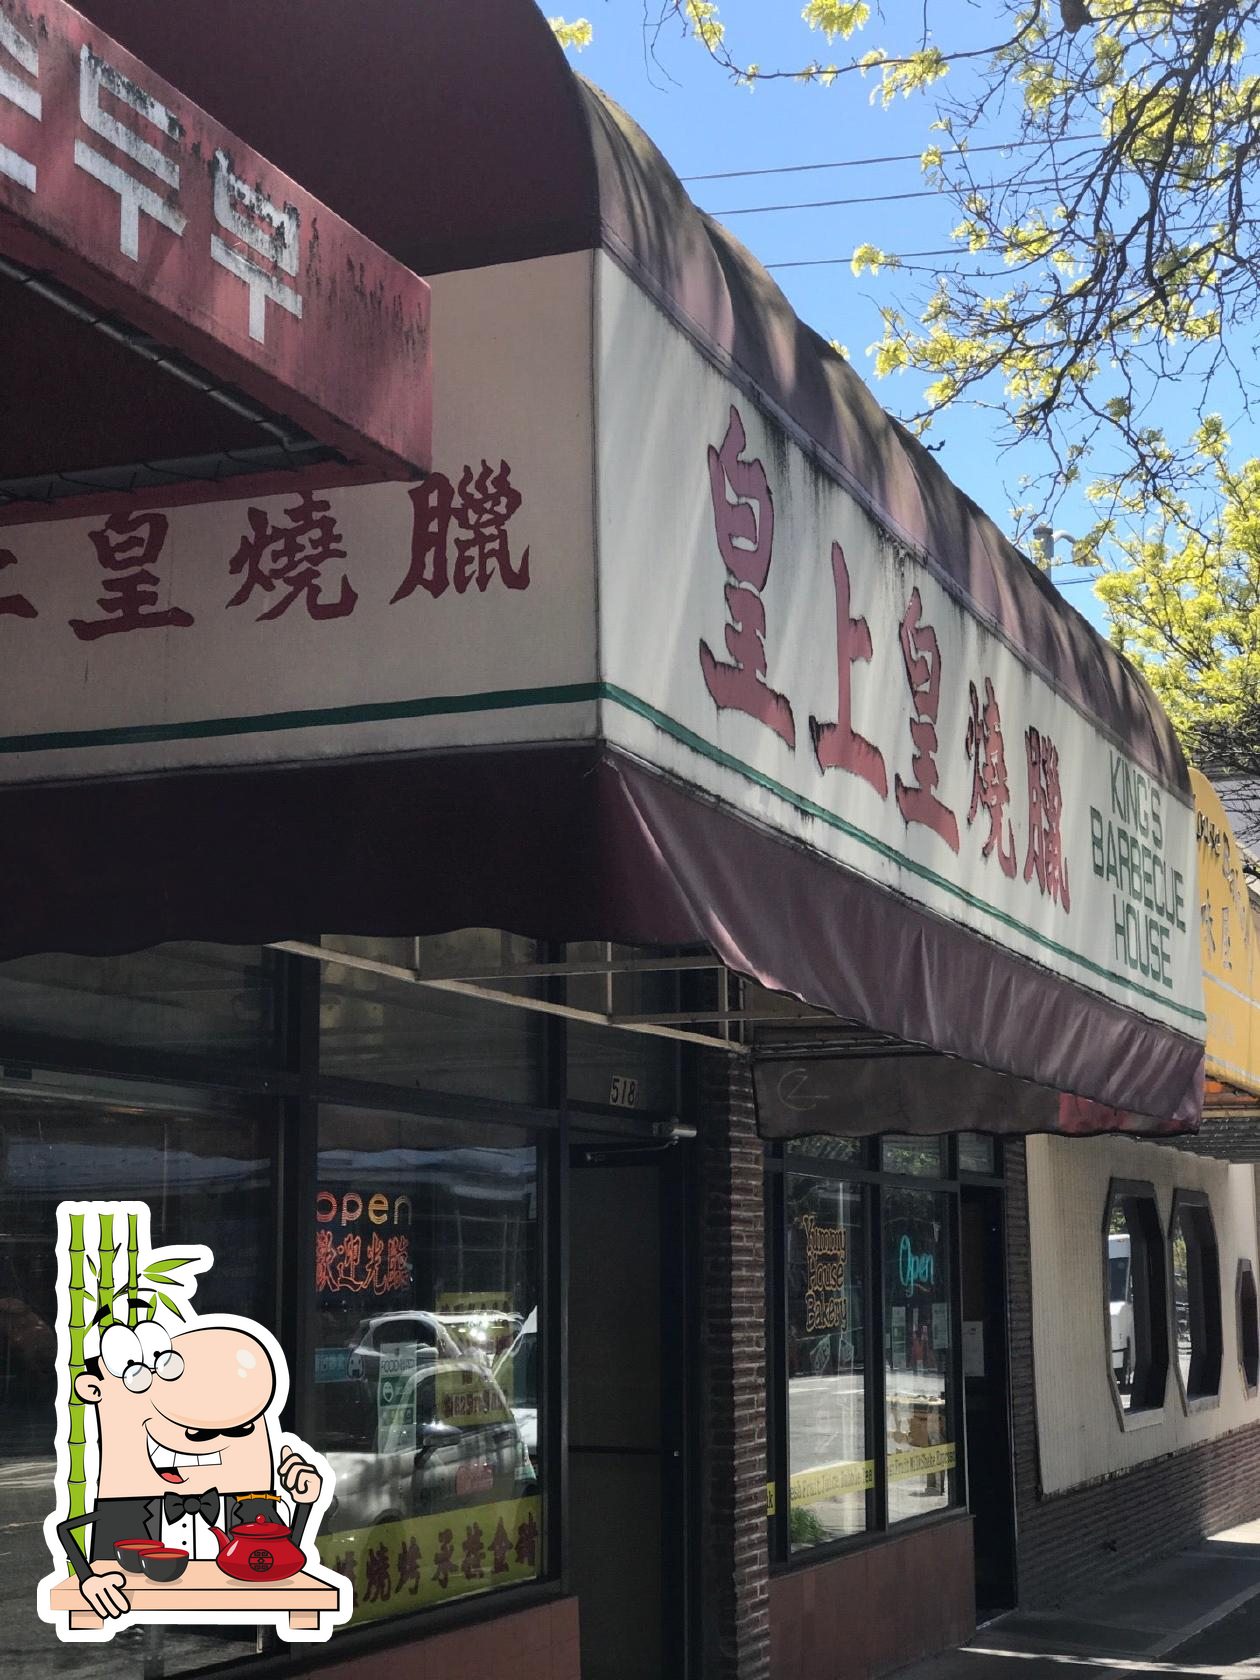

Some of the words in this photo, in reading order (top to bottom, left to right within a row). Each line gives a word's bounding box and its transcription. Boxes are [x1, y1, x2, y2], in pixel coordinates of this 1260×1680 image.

[1110, 750, 1163, 851] KING'S
[1090, 805, 1187, 934] BARBECUE
[1113, 893, 1173, 990] HOUSE
[611, 1078, 635, 1105] 518
[315, 1192, 412, 1227] open
[802, 1213, 847, 1264] Yummy
[807, 1251, 845, 1291] House
[900, 1234, 935, 1297] Open
[805, 1290, 848, 1333] Bakery
